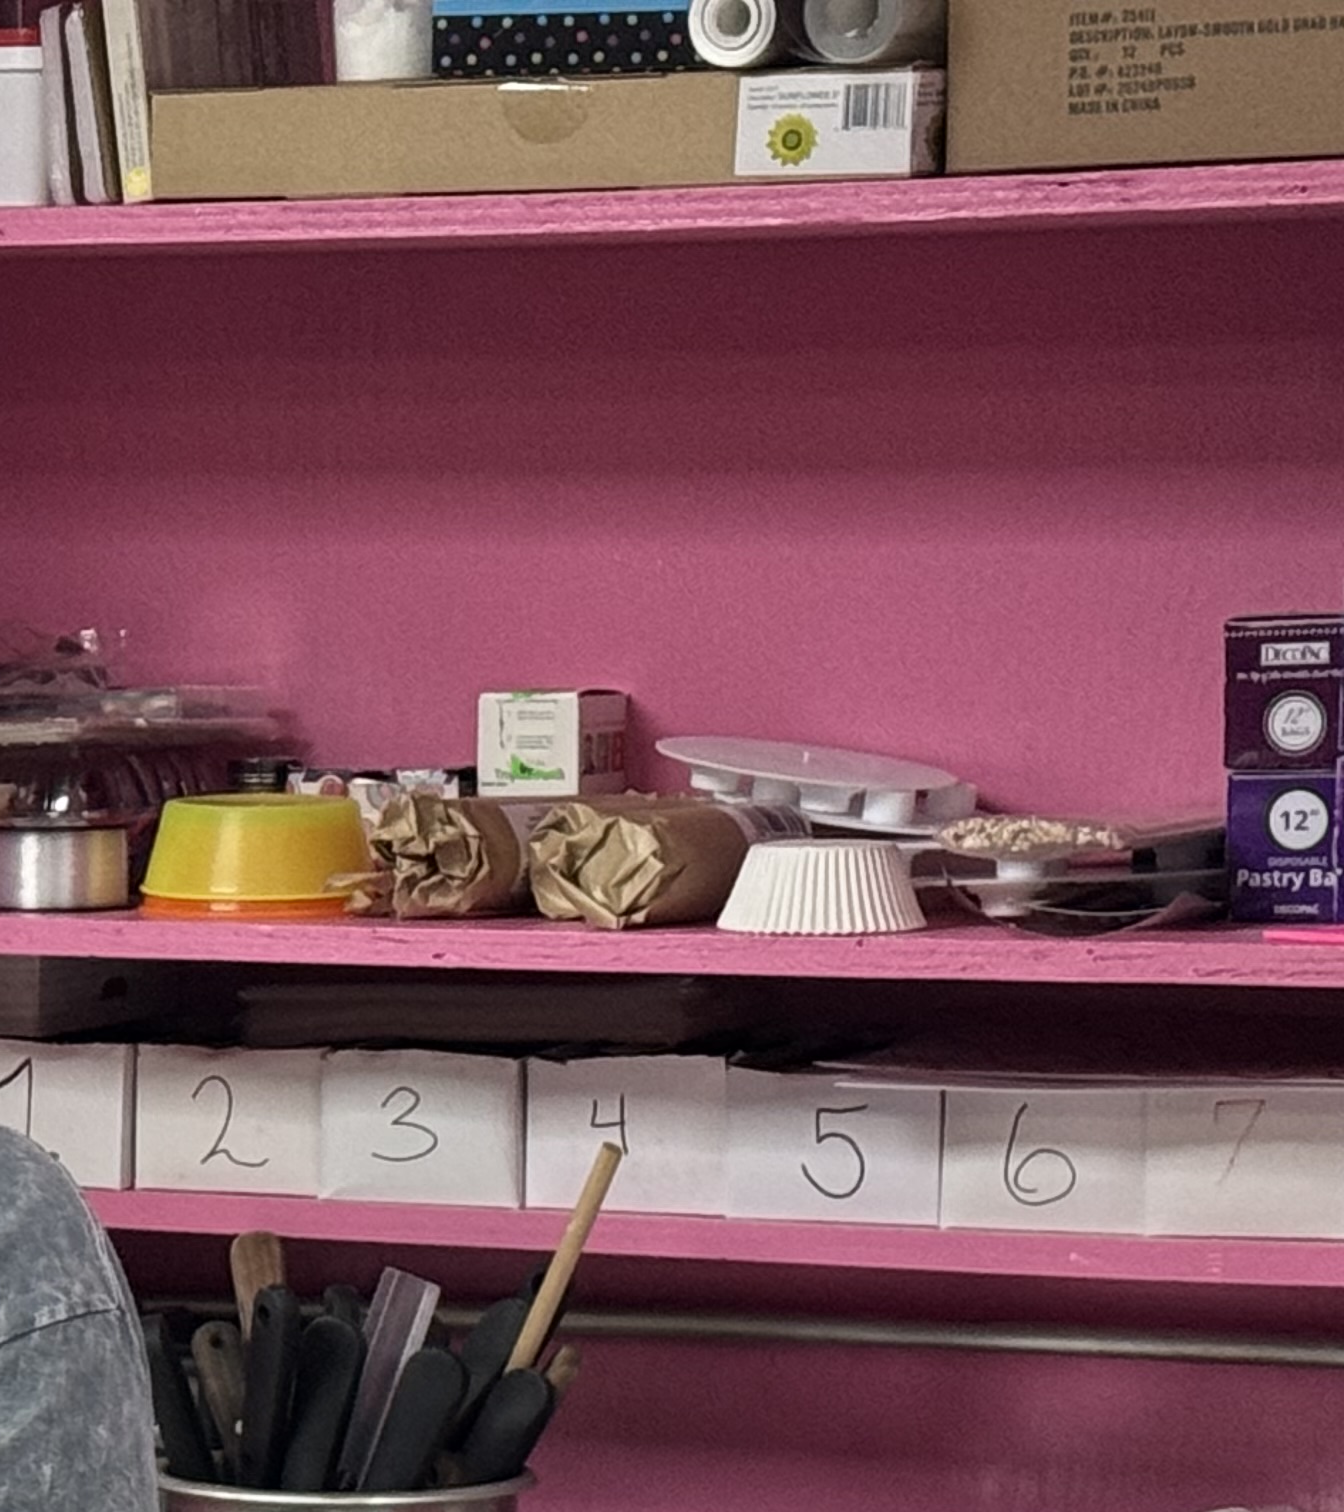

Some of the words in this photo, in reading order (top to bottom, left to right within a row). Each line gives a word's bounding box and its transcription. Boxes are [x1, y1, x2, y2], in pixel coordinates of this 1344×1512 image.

[1236, 868, 1305, 892] Pastry
[191, 1074, 270, 1168] 2
[370, 1085, 439, 1162] 3
[589, 1092, 629, 1155] 4
[800, 1103, 870, 1199] 5
[1003, 1101, 1078, 1207] 6
[1212, 1097, 1268, 1187] 7
